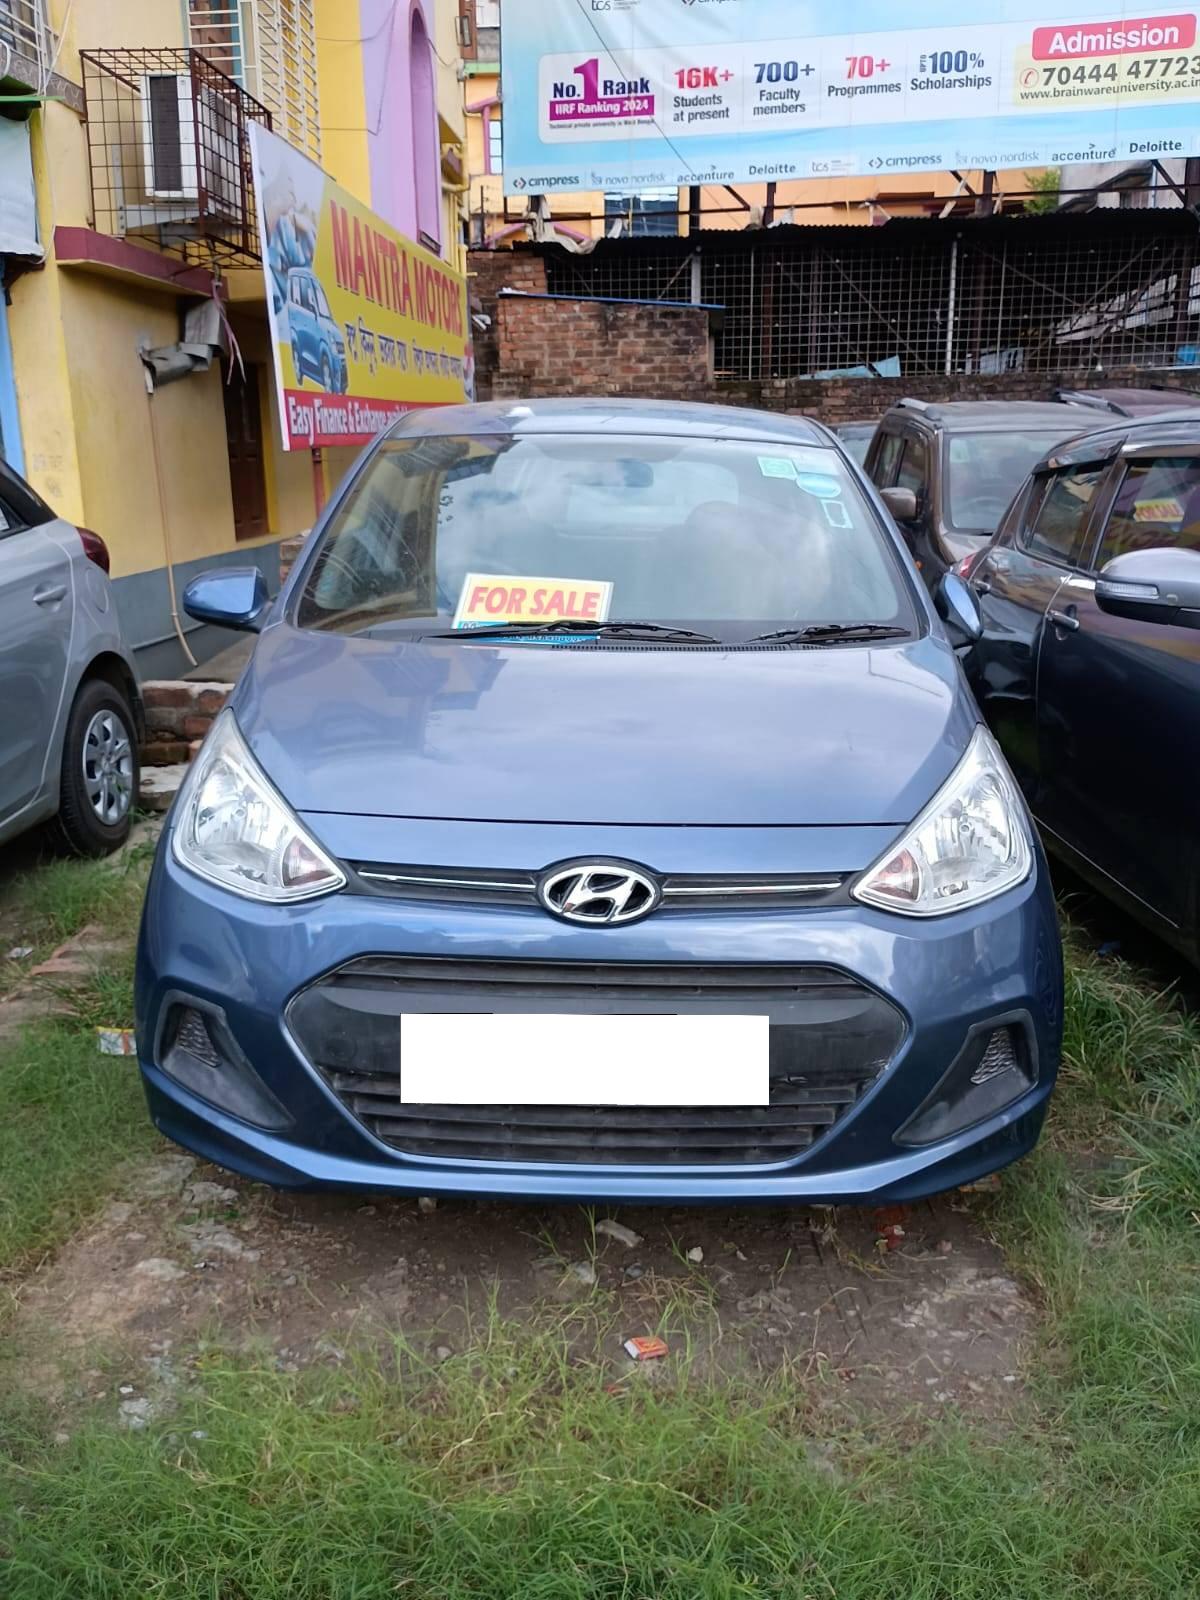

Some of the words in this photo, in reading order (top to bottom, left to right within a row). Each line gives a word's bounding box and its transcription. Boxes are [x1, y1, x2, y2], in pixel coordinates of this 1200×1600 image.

[1048, 23, 1179, 54] Admission
[753, 60, 815, 84] 700+
[845, 55, 891, 79] 70+
[928, 50, 985, 74] 100%
[1042, 63, 1118, 86] 70444
[1127, 55, 1200, 79] 47723
[553, 82, 581, 98] No.
[573, 58, 599, 103] 1
[603, 77, 650, 96] Rank
[674, 66, 734, 89] 16K+
[910, 75, 992, 91] Scholarships
[673, 94, 723, 108] Students
[759, 88, 801, 102] Faculty
[827, 82, 902, 98] Programmes
[555, 103, 576, 115] IIRF
[577, 101, 620, 115] Ranking
[622, 98, 649, 111] 2024
[673, 112, 684, 122] at
[687, 107, 730, 123] present
[753, 102, 806, 116] members
[528, 175, 580, 188] cimpress
[677, 170, 735, 183] accenture
[749, 163, 796, 175] Deloitte
[885, 154, 943, 167] cimpress
[1000, 151, 1040, 162] nordisk
[1052, 150, 1116, 162] accenture
[1129, 140, 1183, 153] Deloitte
[330, 199, 414, 321] MANTRA
[413, 256, 463, 338] MOTORS
[288, 396, 314, 446] Easy
[313, 398, 348, 434] Finance
[347, 401, 356, 433] &
[467, 586, 527, 615] FOR
[529, 588, 601, 618] SALE
